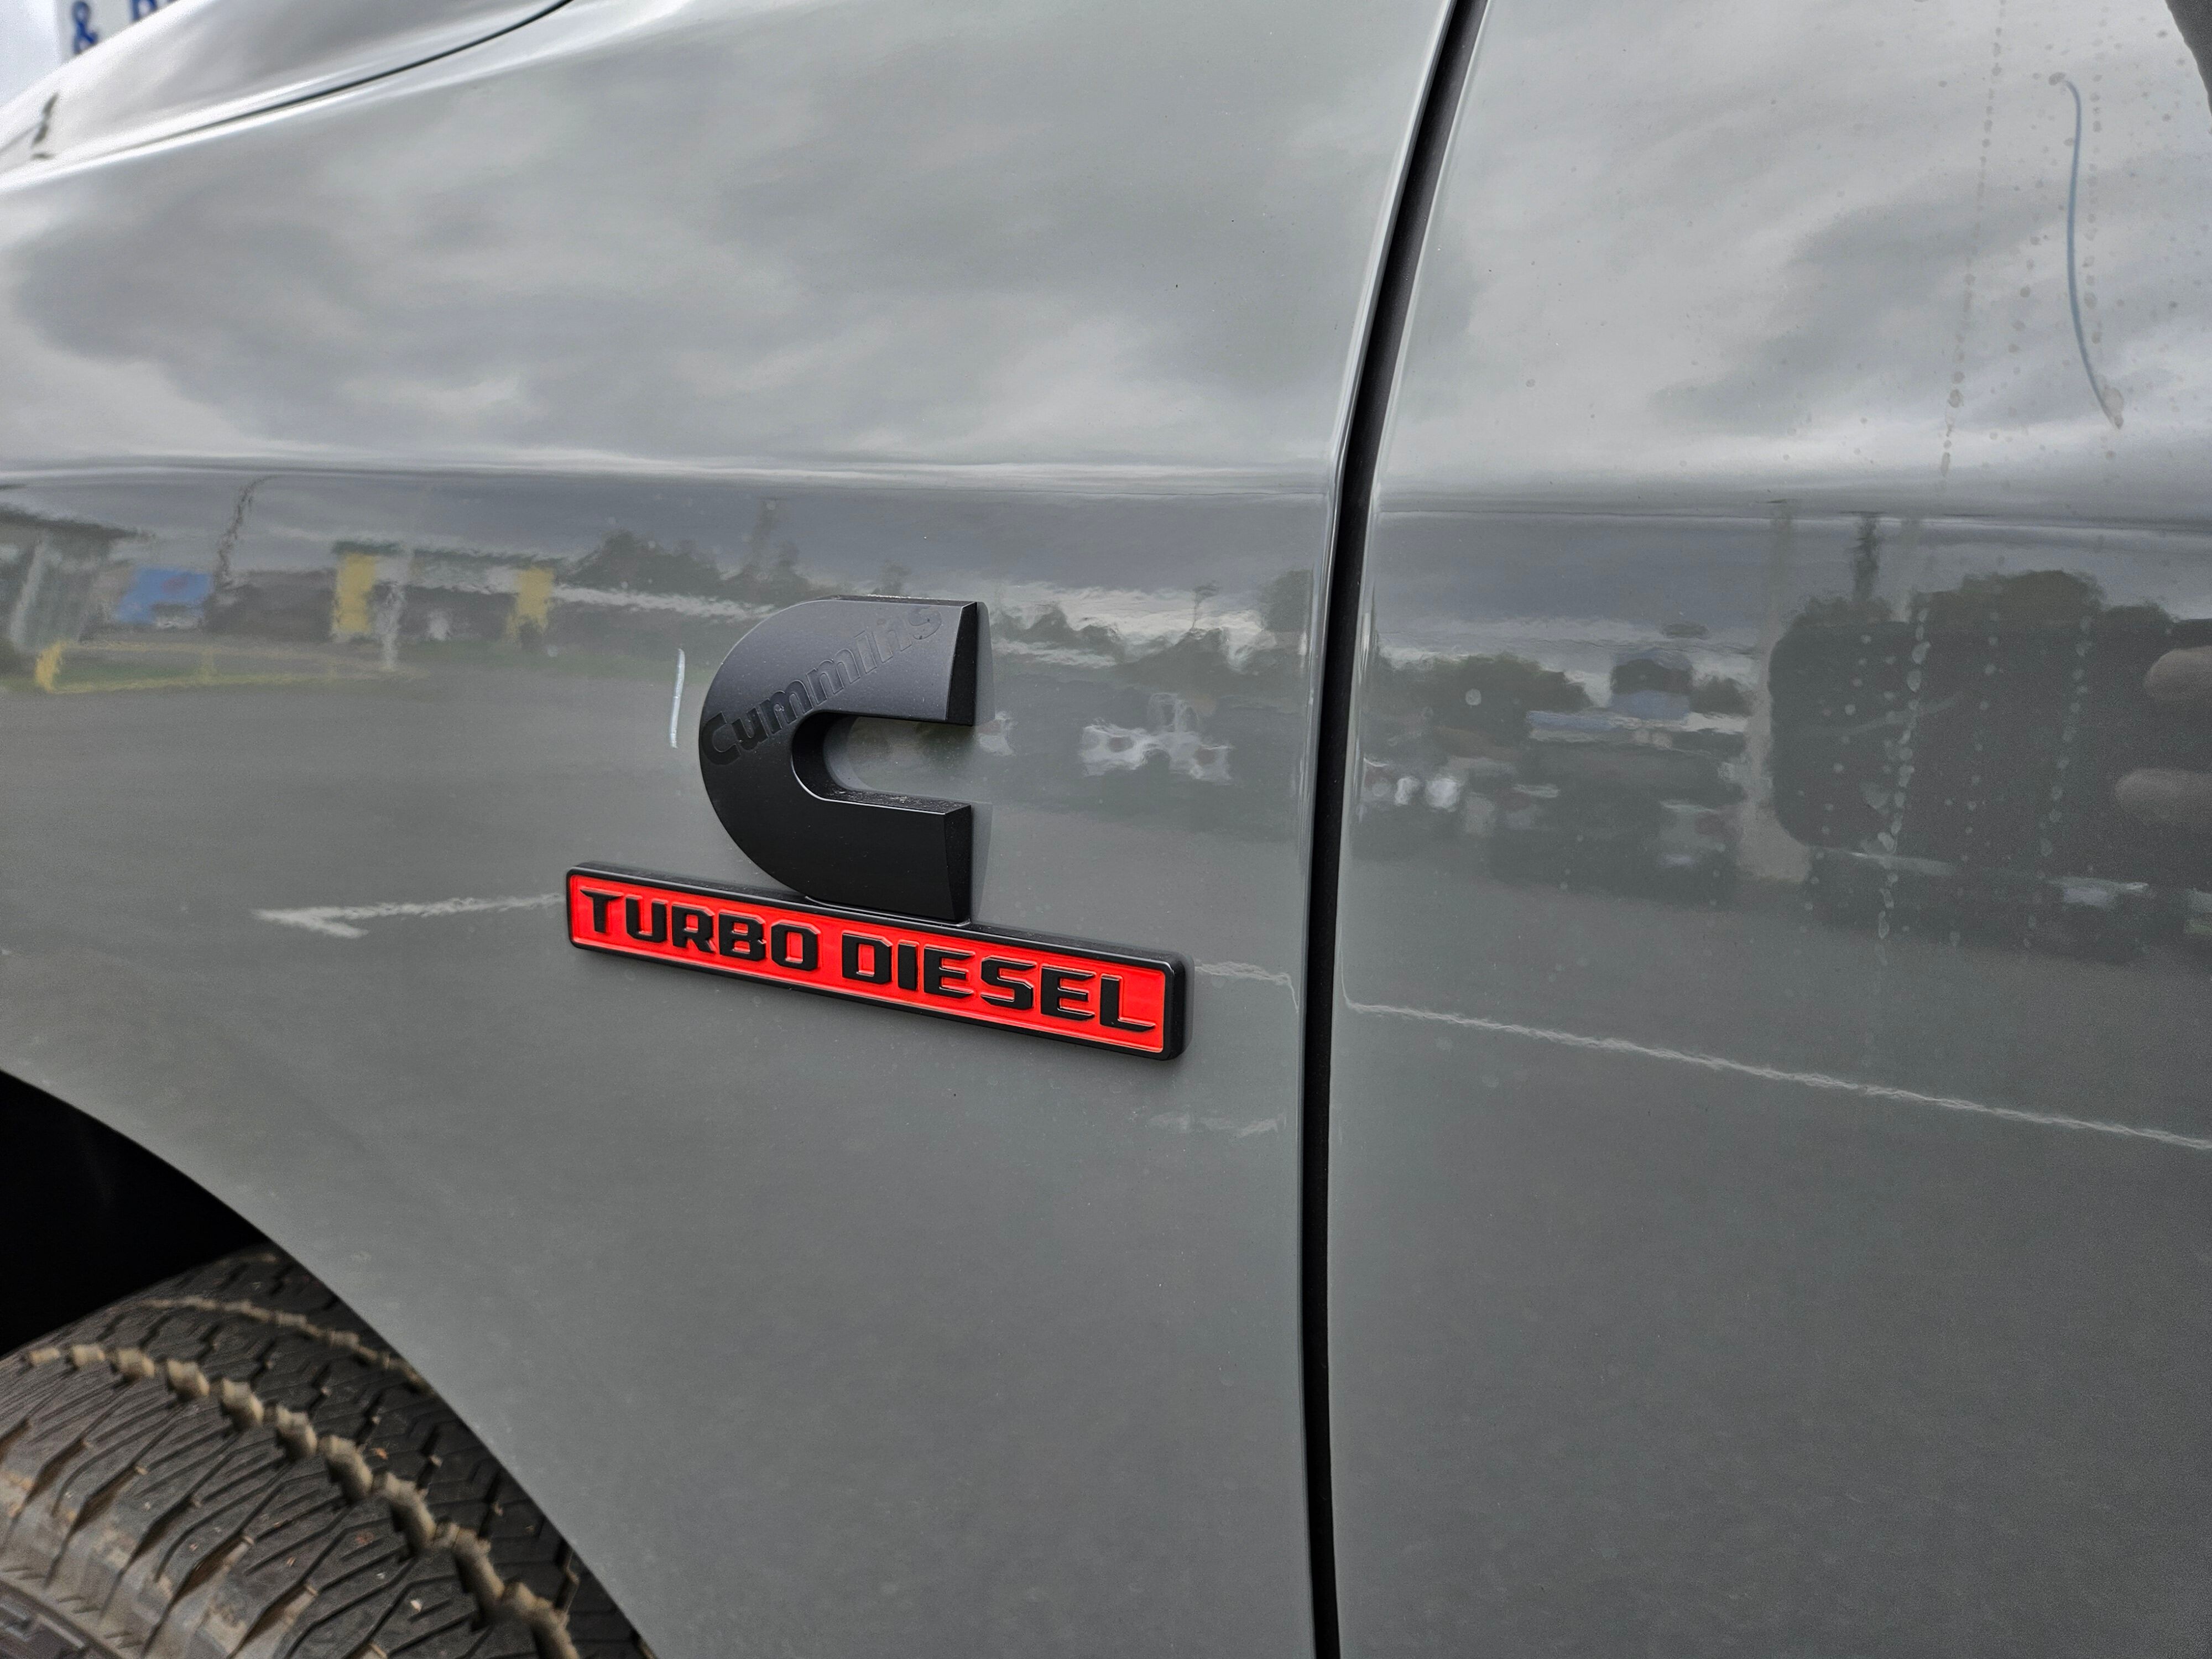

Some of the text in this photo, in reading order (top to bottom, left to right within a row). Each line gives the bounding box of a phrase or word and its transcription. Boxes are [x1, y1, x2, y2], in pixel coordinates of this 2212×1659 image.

[72, 1, 99, 55] &
[701, 606, 942, 766] Cummins
[580, 888, 1156, 1032] TURBO DIESEL
